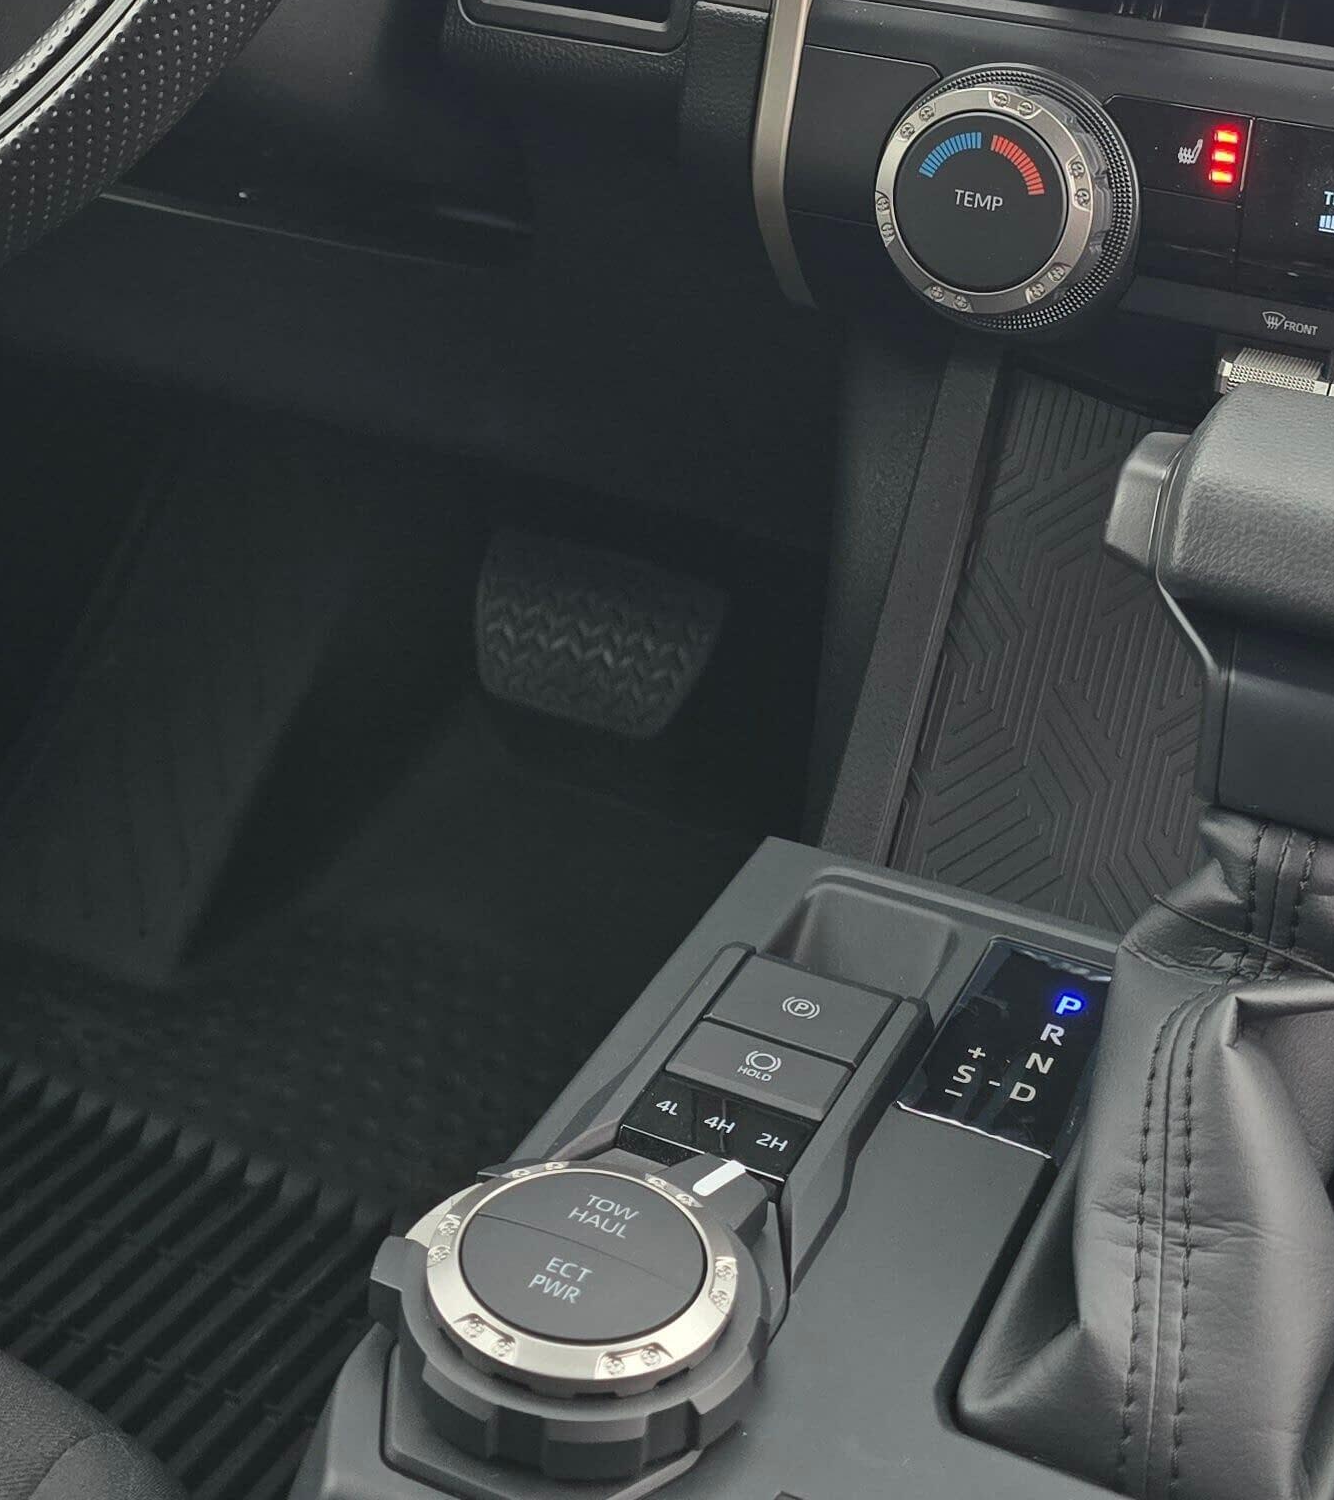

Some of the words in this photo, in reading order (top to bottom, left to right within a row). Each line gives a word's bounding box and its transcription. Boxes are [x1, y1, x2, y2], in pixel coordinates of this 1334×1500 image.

[954, 188, 1004, 212] TEMP
[1283, 321, 1318, 336] FRONT
[1055, 995, 1082, 1015] P
[1039, 1023, 1065, 1046] R
[737, 1065, 772, 1082] HOLD
[952, 1065, 976, 1084] S
[1025, 1053, 1054, 1074] N
[1009, 1082, 1037, 1102] D
[656, 1096, 678, 1118] 4L
[704, 1112, 735, 1136] 4H
[756, 1131, 789, 1153] 2H
[586, 1194, 640, 1221] TOW
[567, 1207, 627, 1239] HAUL
[545, 1257, 593, 1283] ECT
[527, 1275, 582, 1304] PWR
